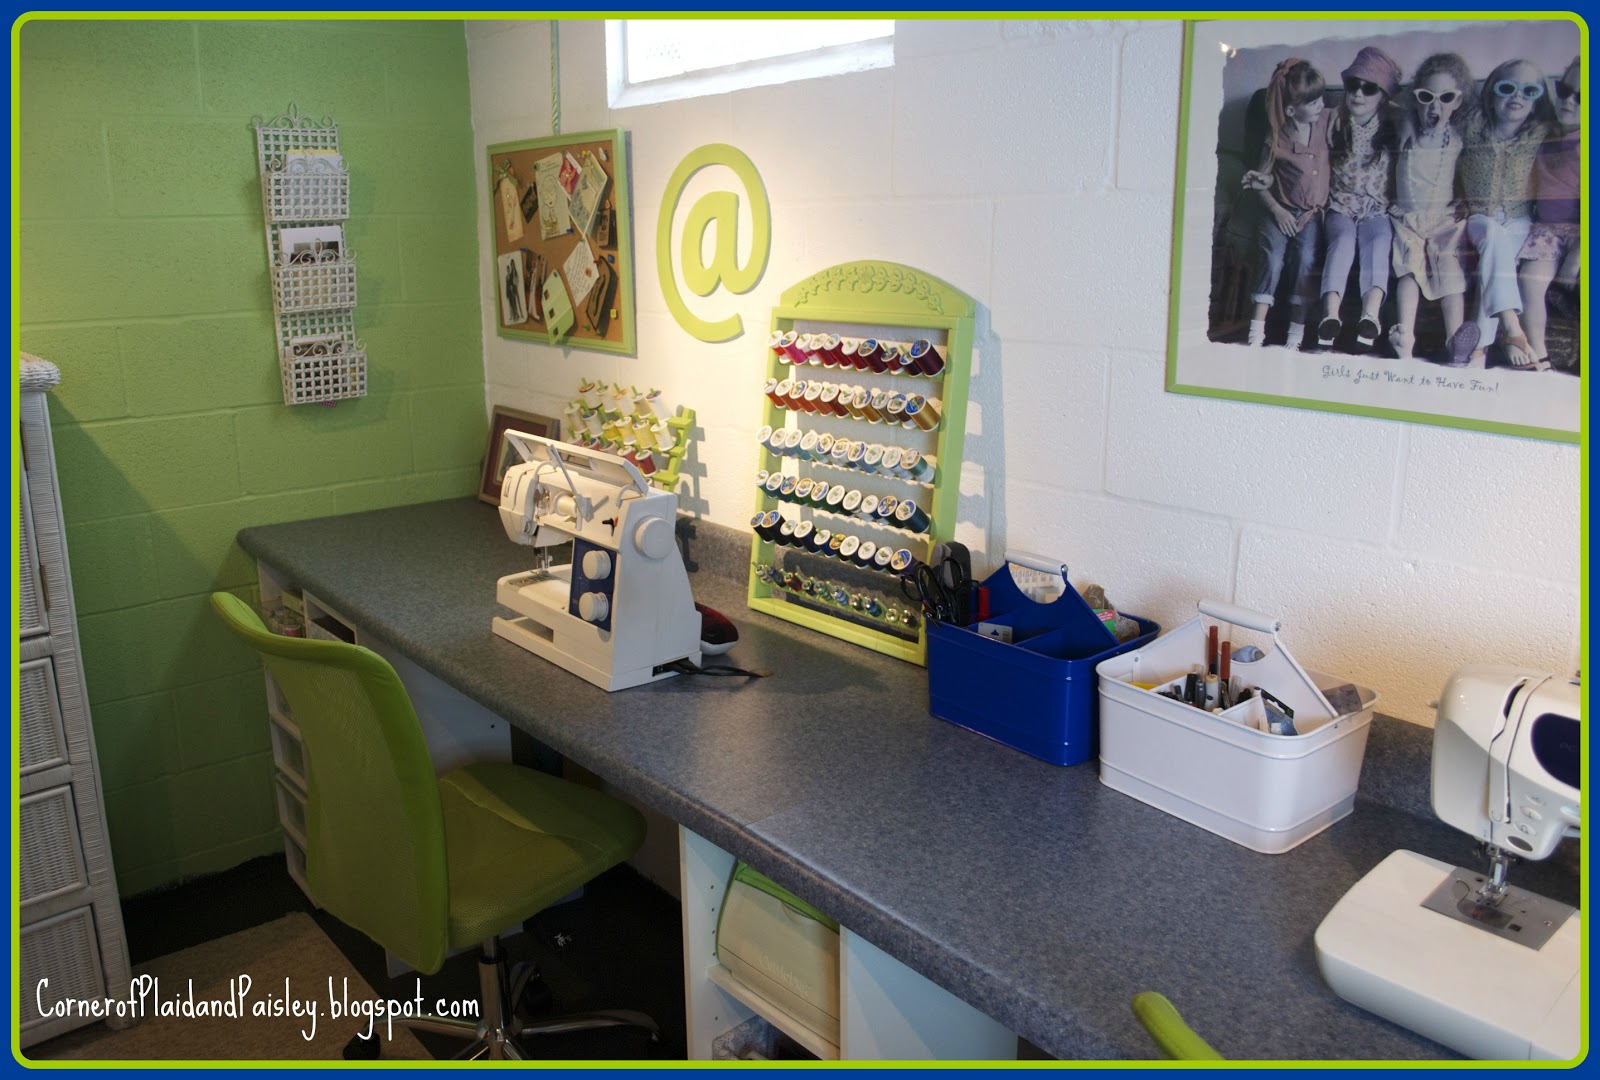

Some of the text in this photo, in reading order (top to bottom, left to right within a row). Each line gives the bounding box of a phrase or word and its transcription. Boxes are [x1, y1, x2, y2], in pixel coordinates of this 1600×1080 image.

[1322, 365, 1500, 393] Girls Just Want to Have Fun!
